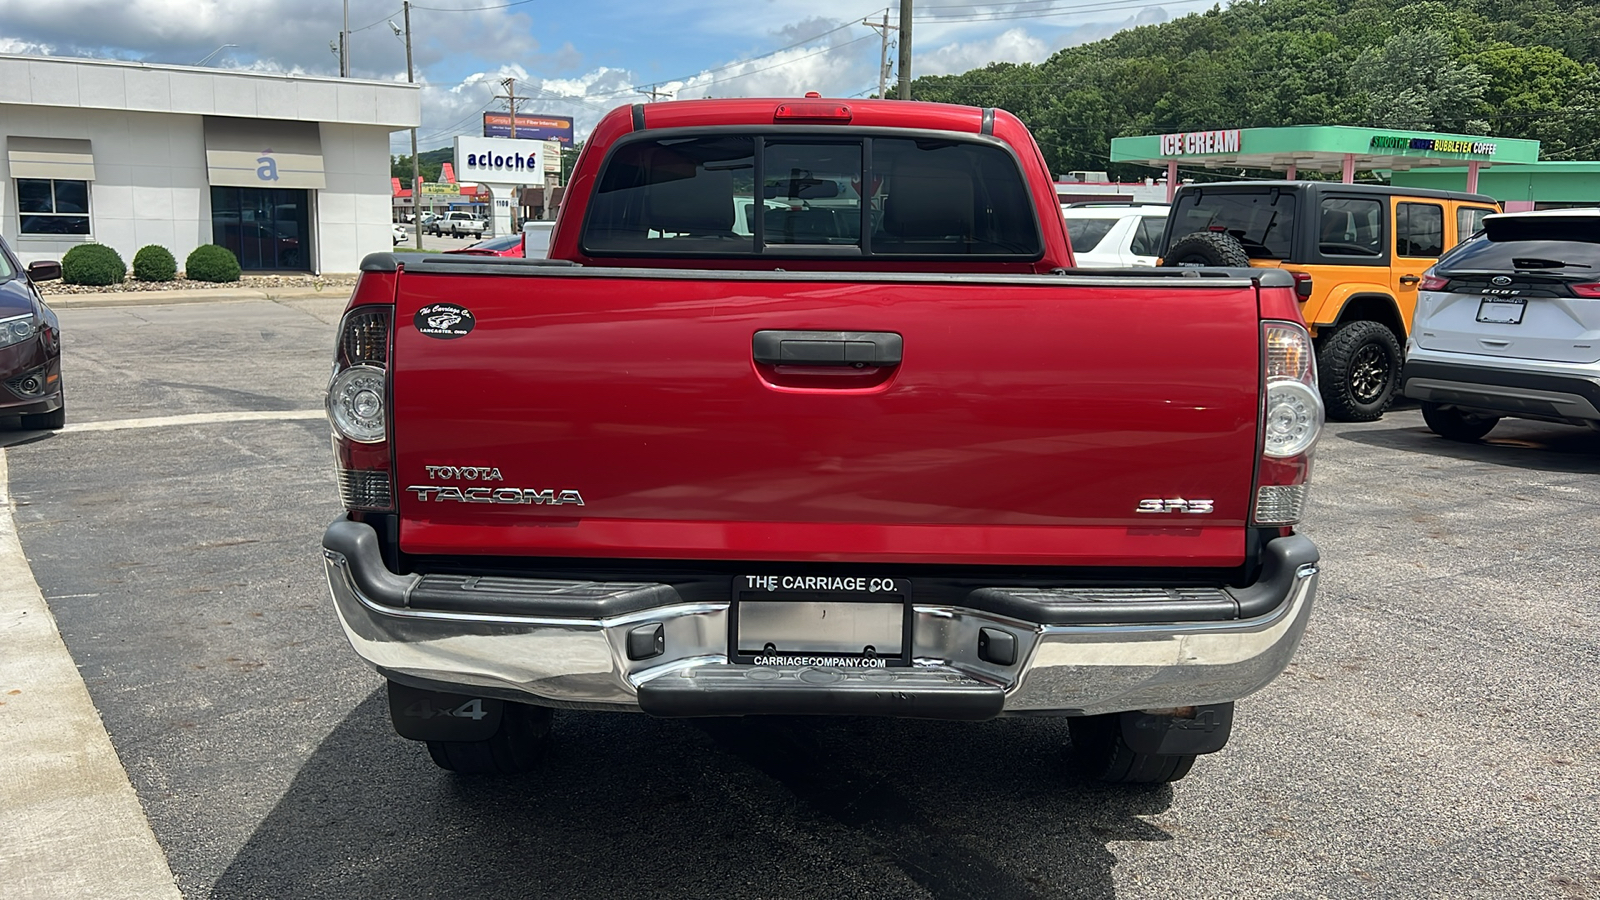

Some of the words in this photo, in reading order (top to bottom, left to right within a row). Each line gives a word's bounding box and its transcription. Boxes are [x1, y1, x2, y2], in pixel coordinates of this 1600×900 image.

[1160, 133, 1184, 156] ICE
[1185, 130, 1241, 154] CREAM
[1472, 142, 1497, 155] COFFEE
[467, 151, 536, 170] acloché
[419, 306, 431, 316] The
[432, 304, 460, 315] Carriage
[425, 465, 504, 481] TOYOTA
[405, 485, 585, 506] TACOMA
[1136, 498, 1215, 514] SR5
[746, 575, 778, 589] THE
[782, 576, 866, 591] CARRIAGE
[869, 577, 898, 592] CO.
[753, 656, 887, 669] CARRIAGECOMPANY.COM
[403, 698, 488, 720] 4x4
